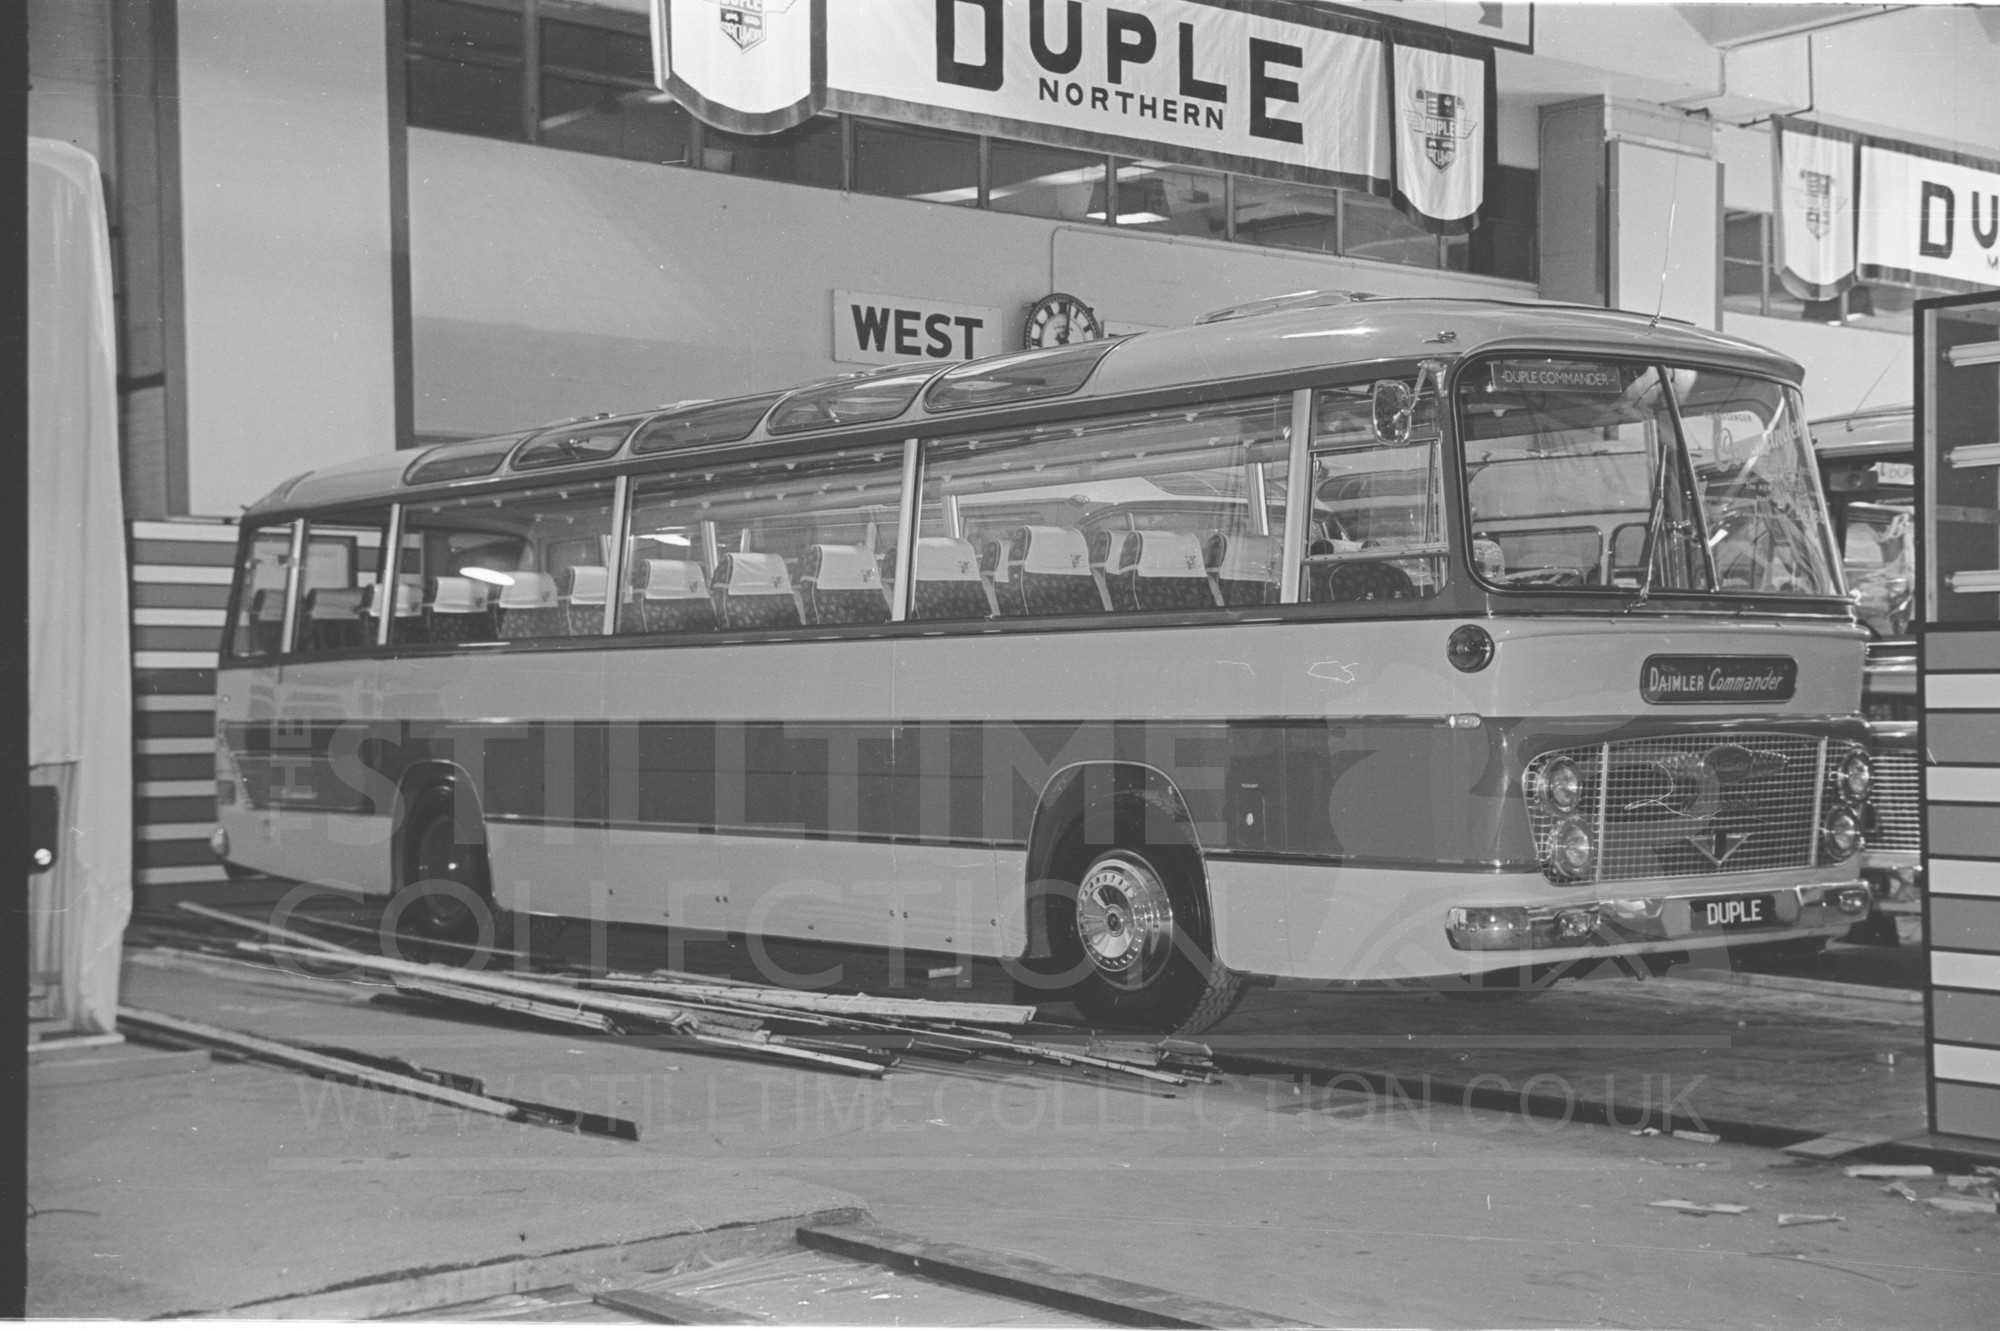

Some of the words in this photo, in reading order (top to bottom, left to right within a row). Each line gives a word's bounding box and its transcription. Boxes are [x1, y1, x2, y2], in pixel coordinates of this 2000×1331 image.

[935, 0, 1304, 145] DUPLE
[1038, 77, 1224, 131] NORTHERN
[850, 303, 984, 361] WEST
[1649, 667, 1705, 692] DAIMLER
[1708, 667, 1785, 691] Commander
[1707, 899, 1763, 926] DUPLE
